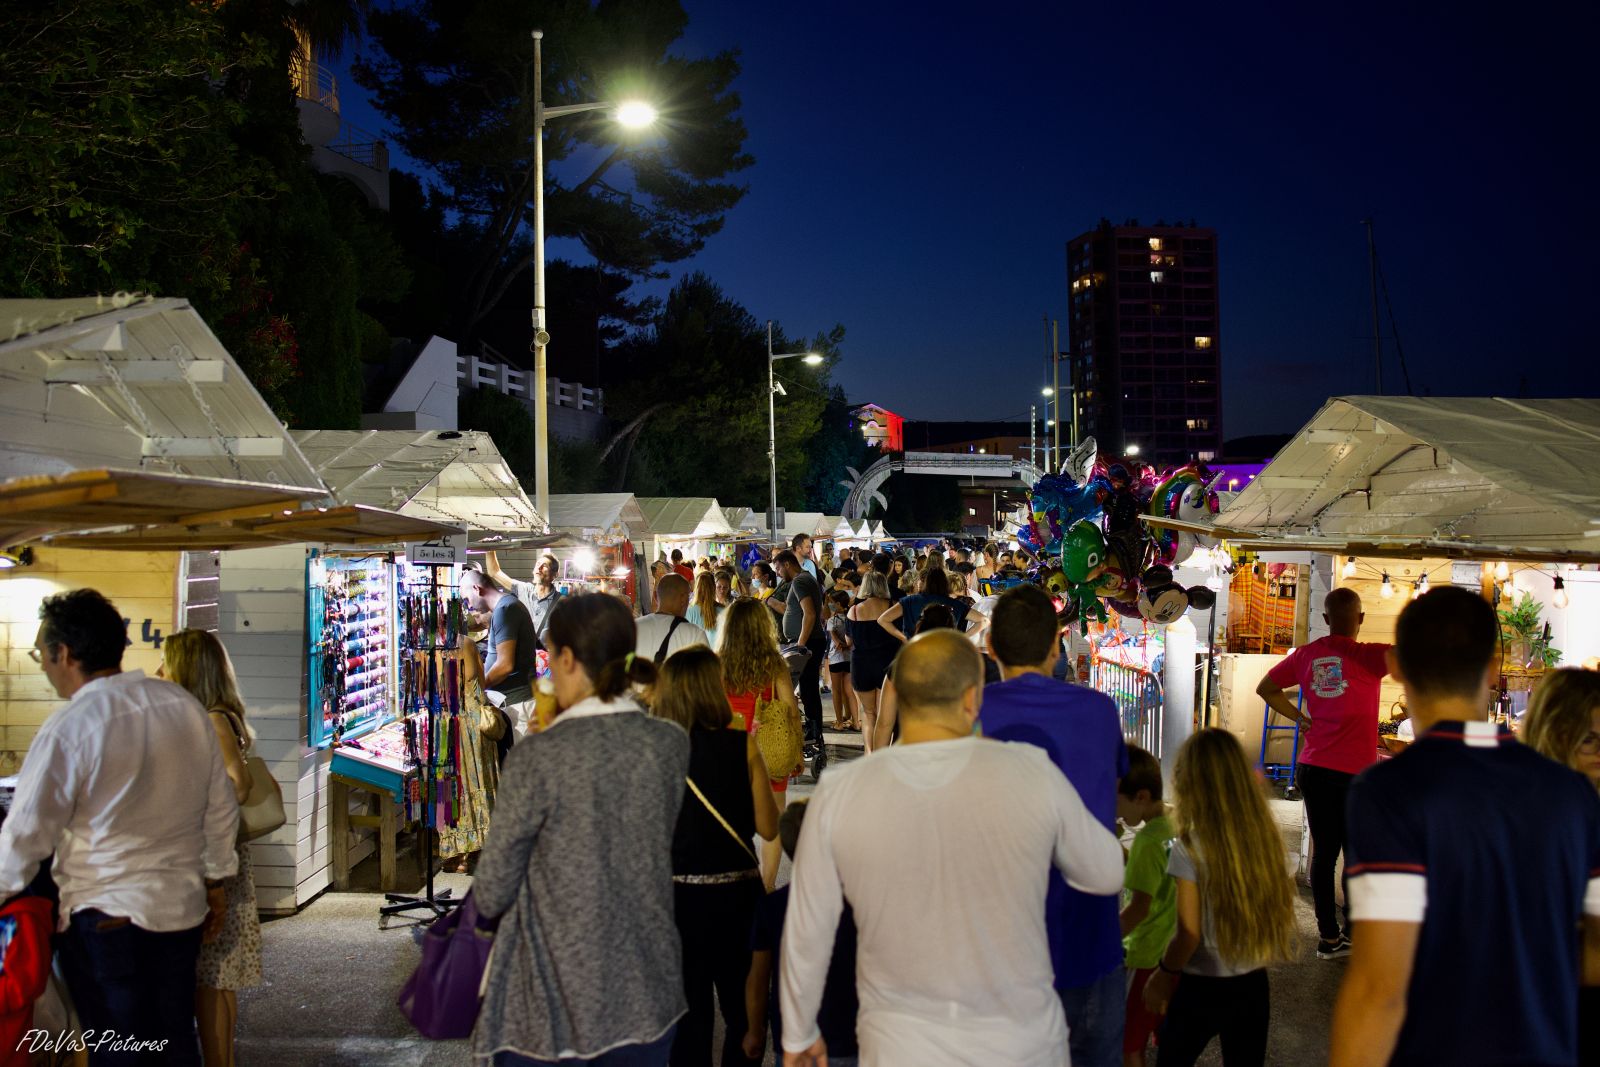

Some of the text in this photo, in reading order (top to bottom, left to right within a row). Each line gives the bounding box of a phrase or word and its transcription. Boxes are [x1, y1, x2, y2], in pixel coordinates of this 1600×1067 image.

[432, 549, 446, 559] les
[447, 550, 454, 559] 3
[141, 618, 165, 649] 4
